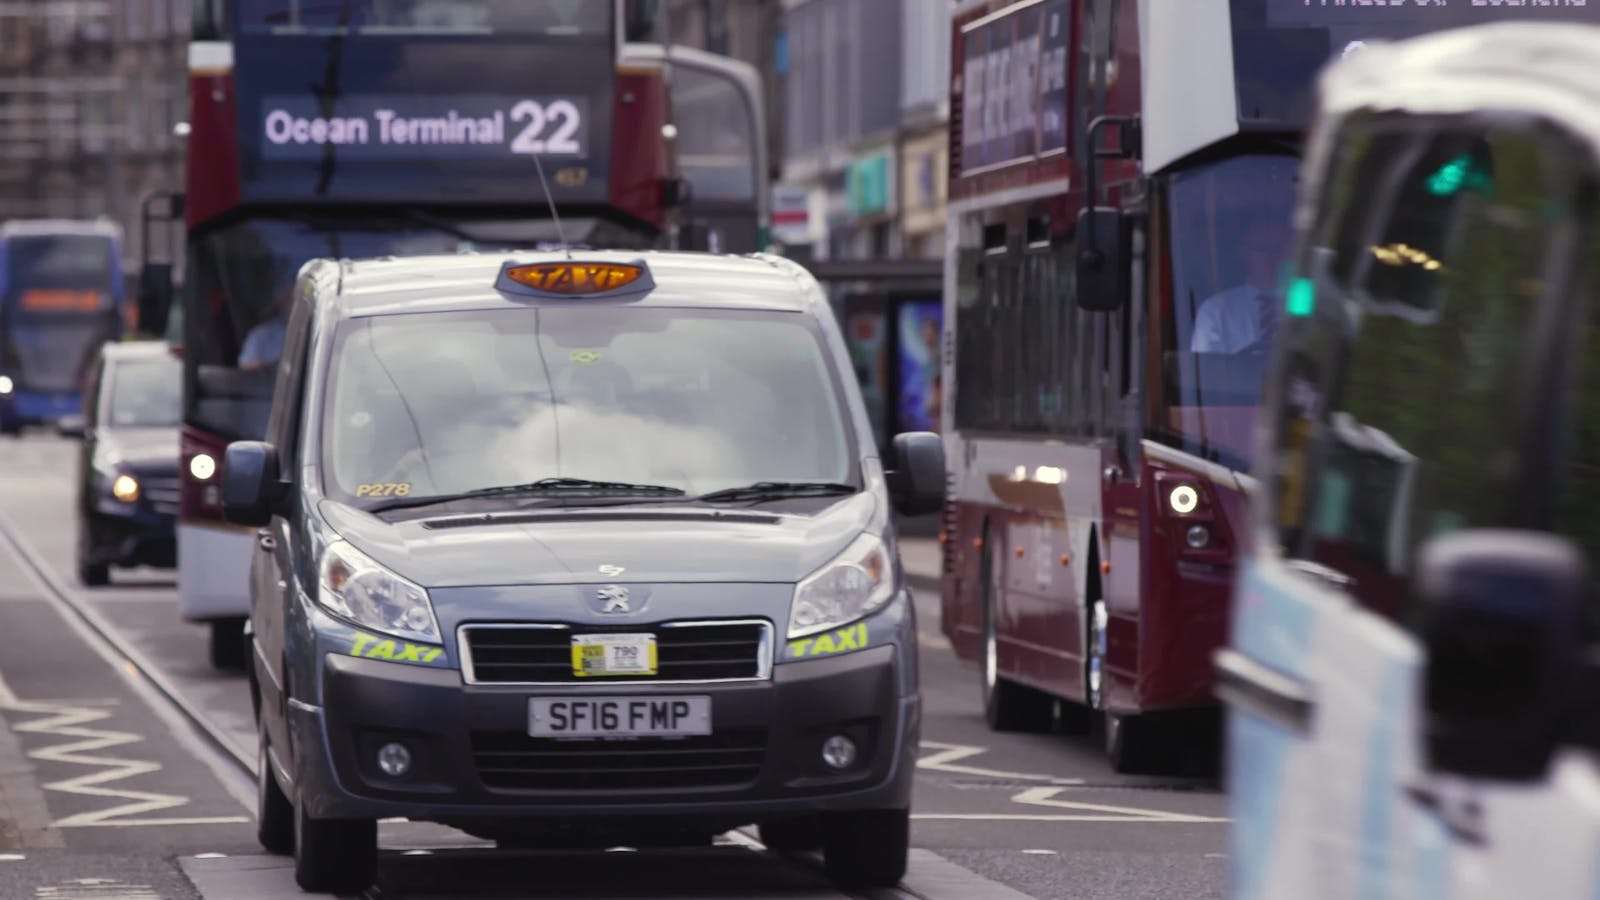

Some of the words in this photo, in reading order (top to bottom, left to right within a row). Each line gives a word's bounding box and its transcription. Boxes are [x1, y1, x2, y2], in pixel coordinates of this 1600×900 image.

[265, 109, 369, 144] Ocean
[374, 109, 504, 144] Terminal
[510, 100, 580, 153] 22
[538, 267, 613, 291] TAXI
[356, 482, 411, 497] P278
[350, 631, 446, 663] TAXI
[788, 622, 868, 657] TAXI
[549, 702, 619, 731] SF16
[628, 701, 690, 730] FMP
